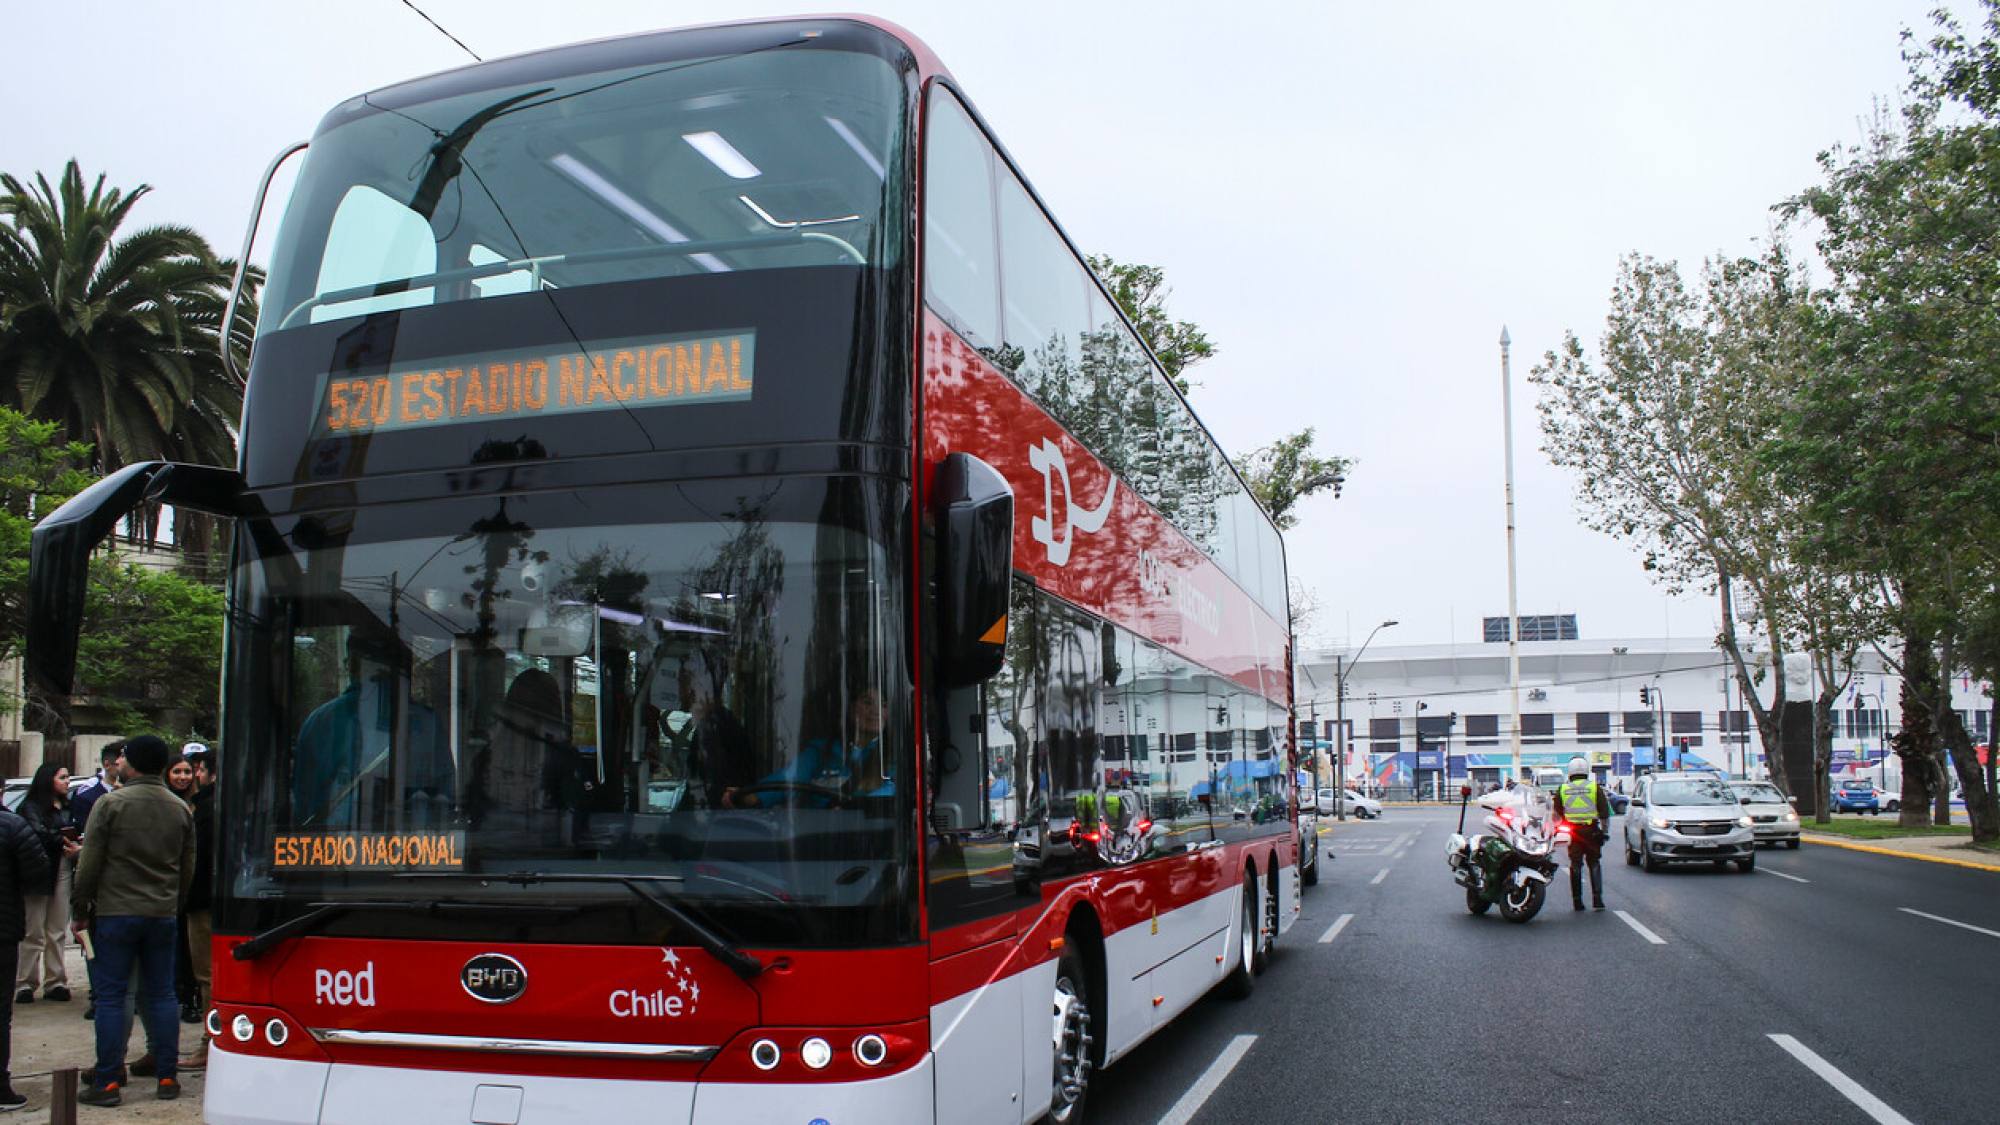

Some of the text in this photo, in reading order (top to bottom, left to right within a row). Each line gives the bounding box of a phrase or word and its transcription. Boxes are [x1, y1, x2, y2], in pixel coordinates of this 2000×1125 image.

[327, 336, 753, 430] 520 ESTADIO NACIONAL
[274, 835, 462, 866] ESTADIO NACIONAL
[315, 960, 376, 1006] Red
[467, 968, 519, 988] BYD
[609, 989, 684, 1018] Chile
